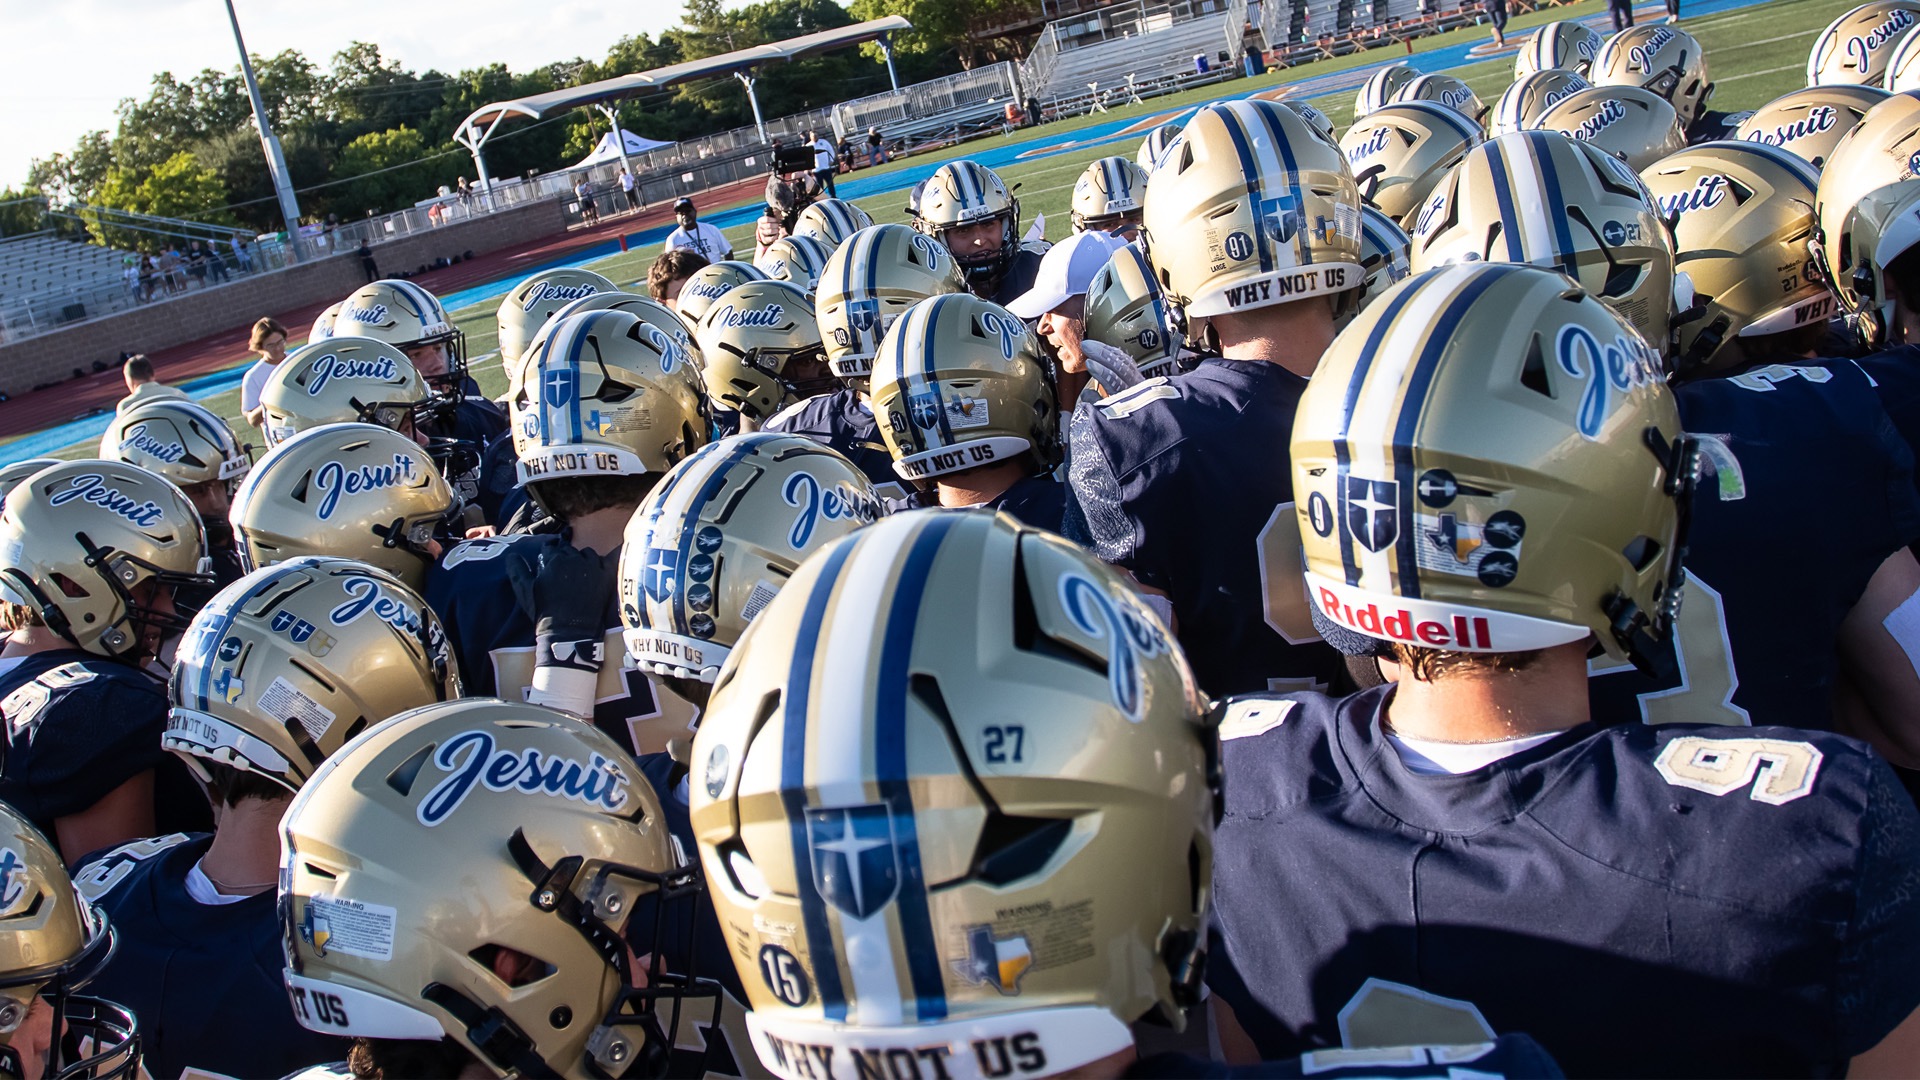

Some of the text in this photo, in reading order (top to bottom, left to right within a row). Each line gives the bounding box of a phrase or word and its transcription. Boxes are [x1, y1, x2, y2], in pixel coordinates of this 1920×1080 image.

[1628, 27, 1675, 75] Jesuit
[1847, 9, 1914, 74] Jesuit
[1349, 127, 1392, 165] suit
[1658, 173, 1728, 215] suit
[1229, 234, 1248, 258] 91
[1627, 224, 1641, 240] 27
[1210, 262, 1227, 273] LARGE
[1782, 275, 1797, 292] 27
[1224, 268, 1345, 307] WHY NOT US
[717, 303, 786, 331] Jesuit
[1795, 297, 1832, 324] WHY
[835, 329, 847, 345] 89
[1141, 330, 1156, 347] 42
[308, 354, 398, 396] Jesuit
[836, 359, 858, 374] WHY
[525, 415, 537, 437] 73
[891, 413, 905, 433] 51
[119, 424, 187, 464] Jesuit
[902, 444, 995, 478] WHY NOT US
[524, 453, 619, 477] WHY NOT US
[50, 474, 164, 527] Jesuit
[315, 453, 418, 521] Jesuit
[1312, 495, 1326, 532] 9
[624, 578, 633, 596] 27
[1319, 586, 1492, 649] Riddell
[632, 638, 703, 665] WHY NOT US
[182, 716, 201, 734] NOT
[203, 724, 218, 743] US
[984, 725, 1024, 763] 27
[416, 730, 630, 828] Jesuit
[1654, 737, 1824, 806] 9
[762, 949, 802, 1004] 15
[310, 989, 349, 1028] US
[763, 1030, 1047, 1080] WHY NOT US
